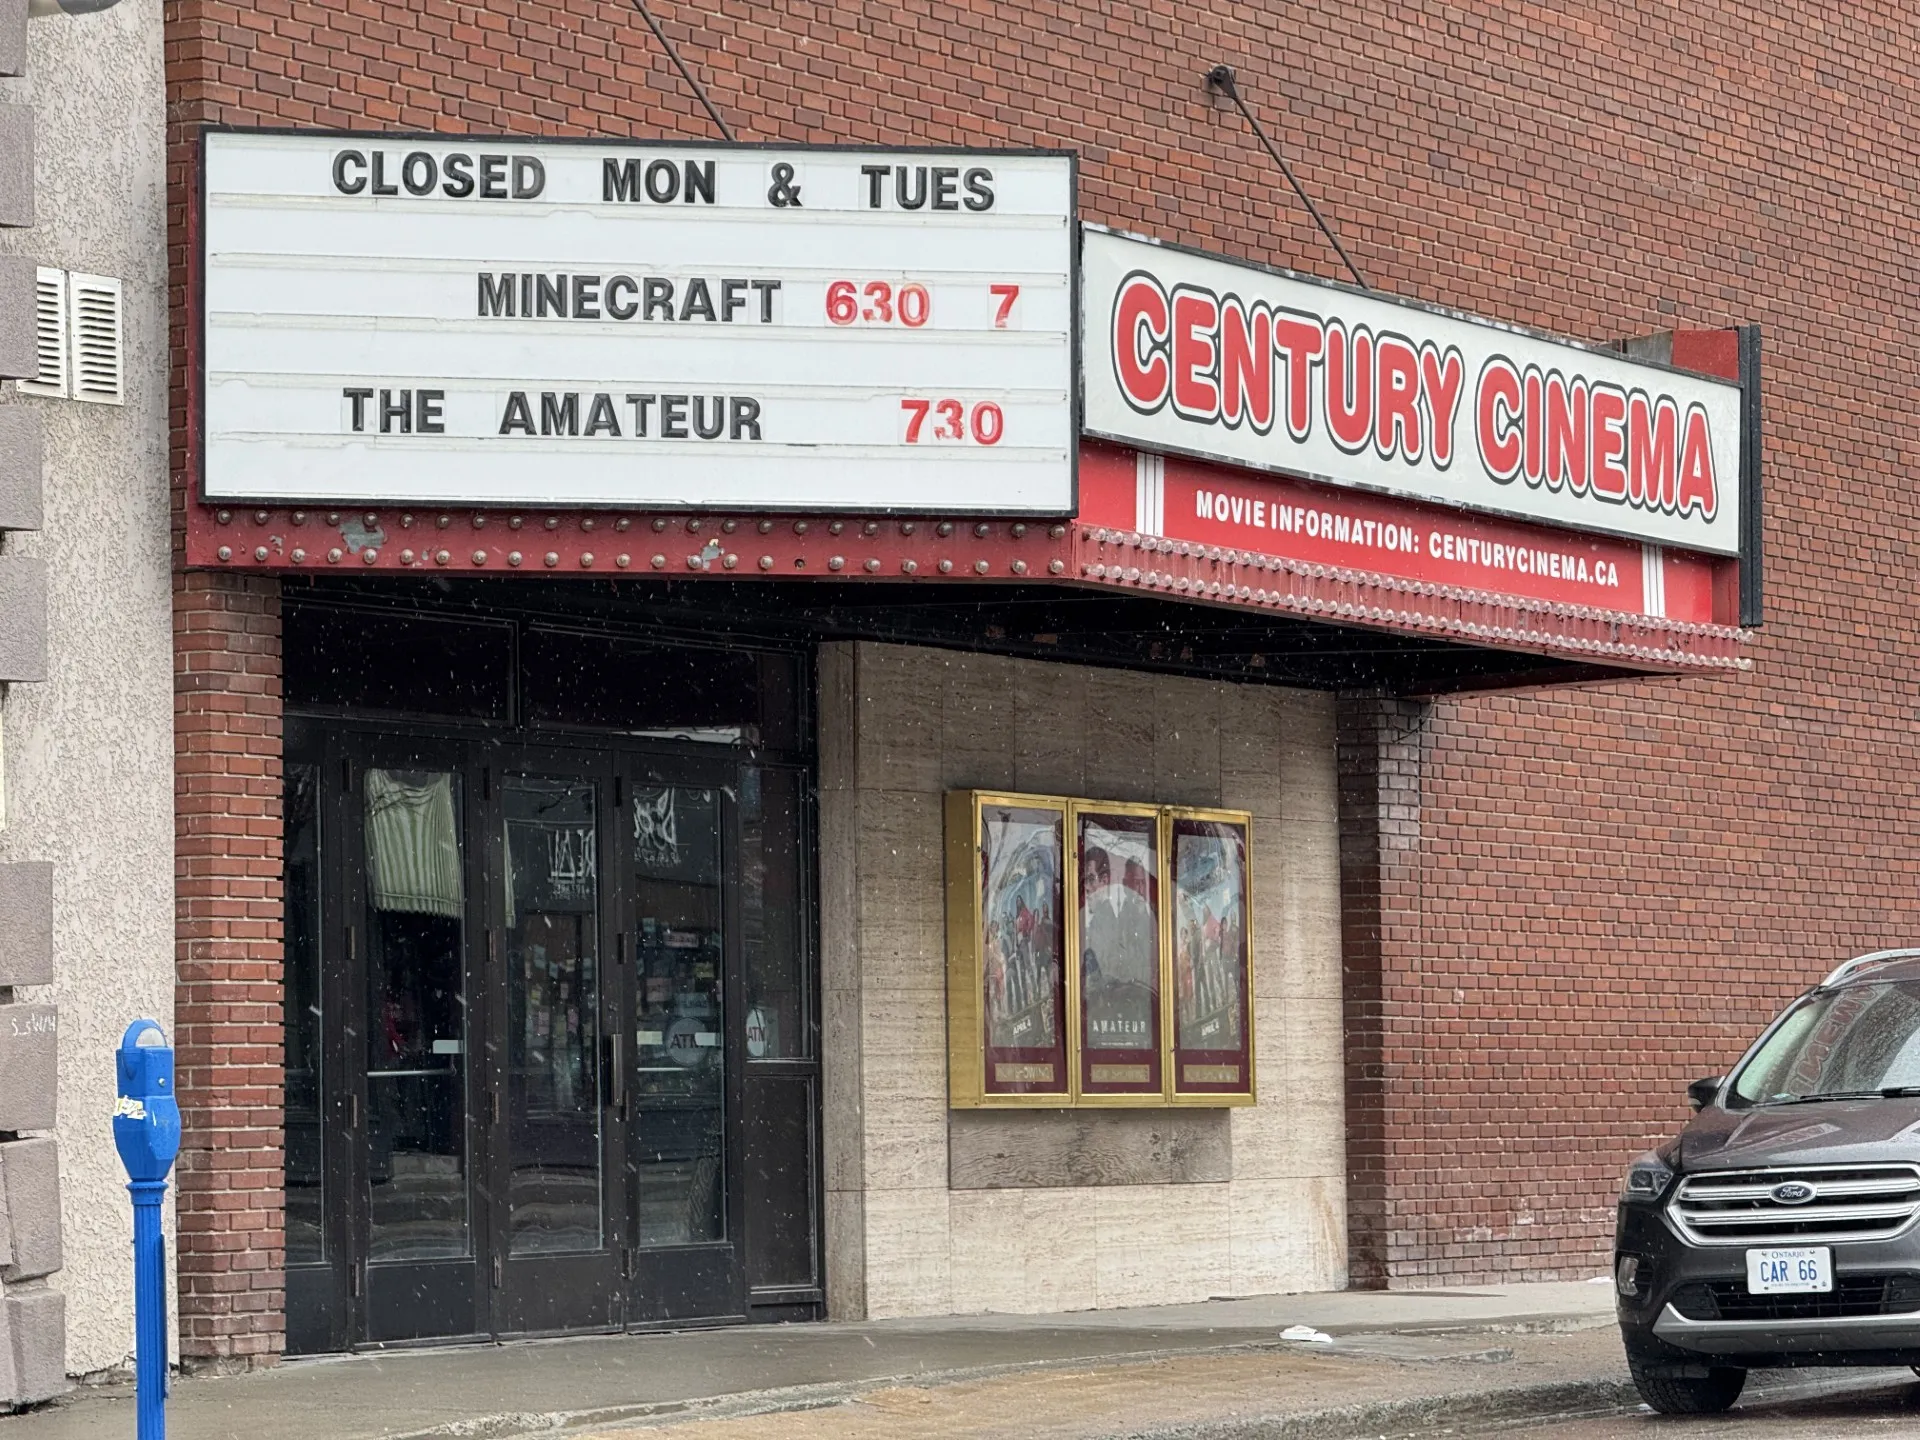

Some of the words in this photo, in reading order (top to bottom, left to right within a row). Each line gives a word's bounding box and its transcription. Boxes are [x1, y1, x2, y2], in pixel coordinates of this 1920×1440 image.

[332, 149, 546, 199] CLOSED
[602, 157, 716, 205] MON
[767, 162, 803, 207] &
[861, 164, 995, 211] TUES
[478, 272, 781, 324] MINECRAFT
[825, 280, 931, 328] 630
[990, 284, 1020, 328] 7
[343, 387, 445, 433] THE
[499, 391, 762, 440] AMATEUR
[901, 398, 1004, 445] 730
[1112, 269, 1465, 471] CENTURY
[1474, 353, 1718, 524] CINEMA
[1196, 490, 1266, 529] MOVIE
[1271, 502, 1420, 553] INFORMATION:
[1428, 531, 1619, 588] CENTURYCINEMA.CA
[1092, 1020, 1146, 1034] AMATEUR
[1780, 1186, 1805, 1198] Ford
[1760, 1261, 1789, 1282] CAR
[1798, 1260, 1817, 1281] 66
[1771, 1250, 1805, 1259] ONTARIO
